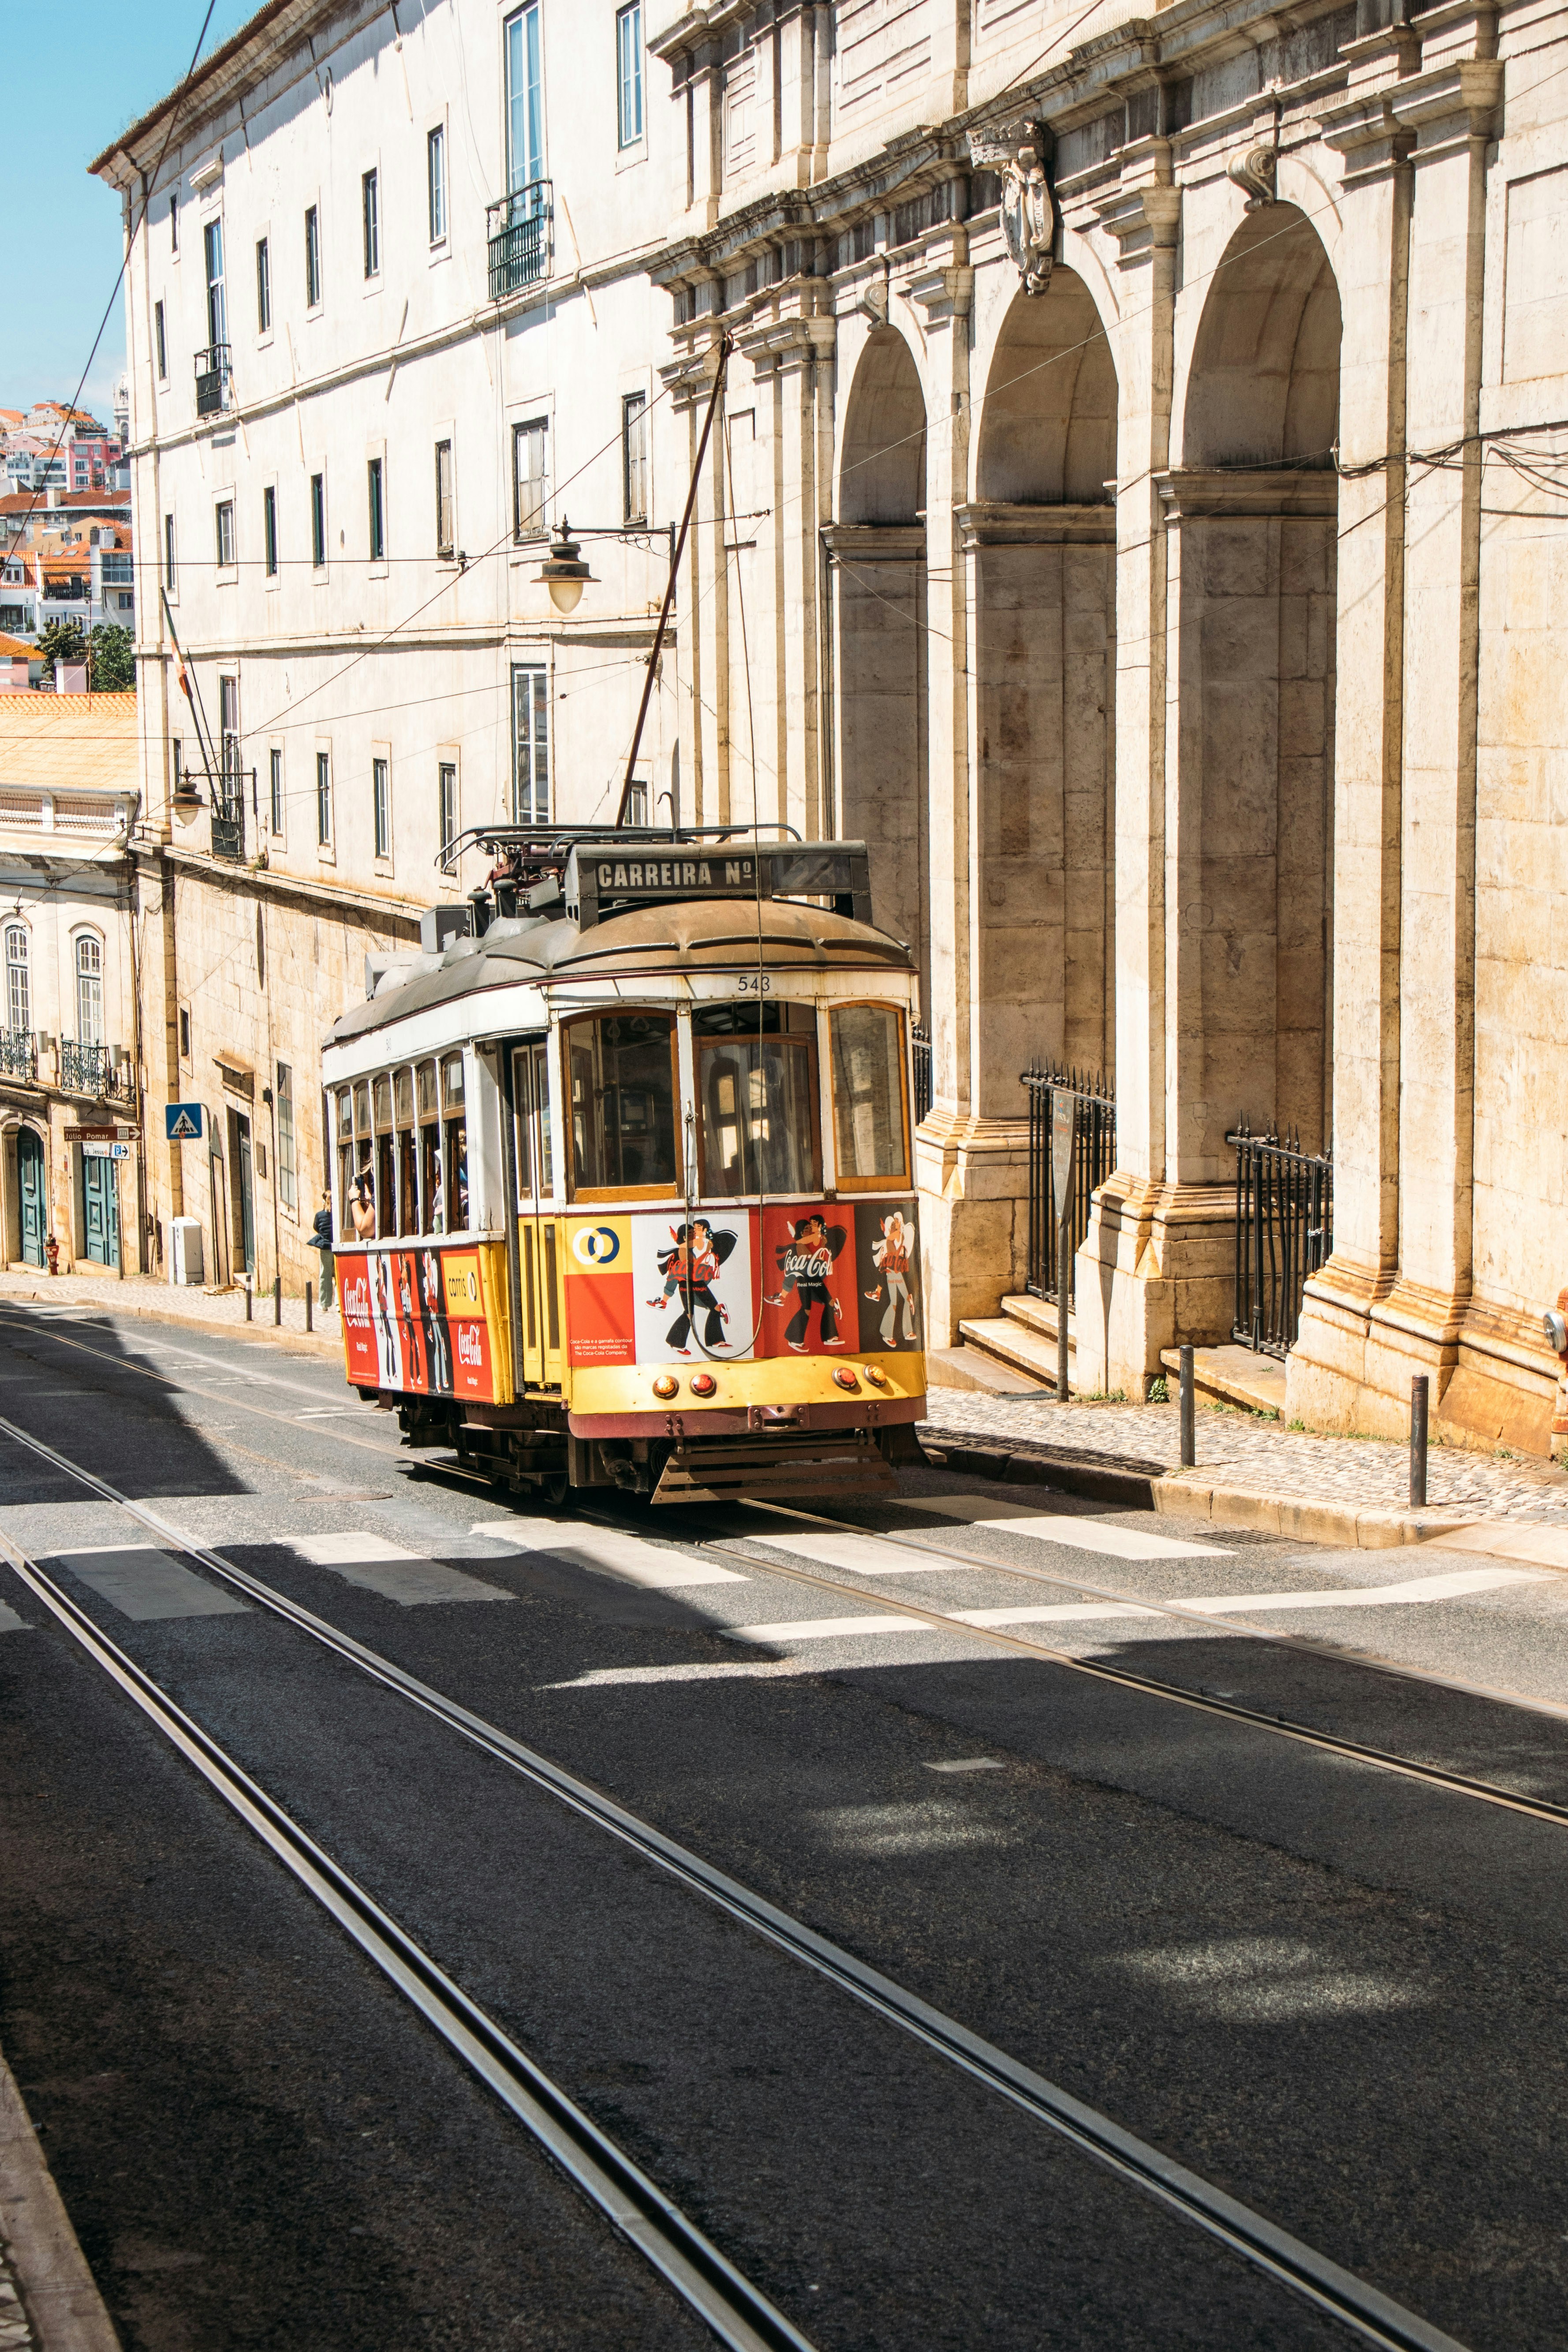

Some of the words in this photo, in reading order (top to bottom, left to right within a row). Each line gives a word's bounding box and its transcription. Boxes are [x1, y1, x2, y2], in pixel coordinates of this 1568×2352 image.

[598, 862, 712, 887] CARREIRA
[725, 862, 751, 884] Nº
[738, 976, 769, 991] 543
[784, 1247, 833, 1277] Coca-Cola
[449, 1269, 466, 1297] carris
